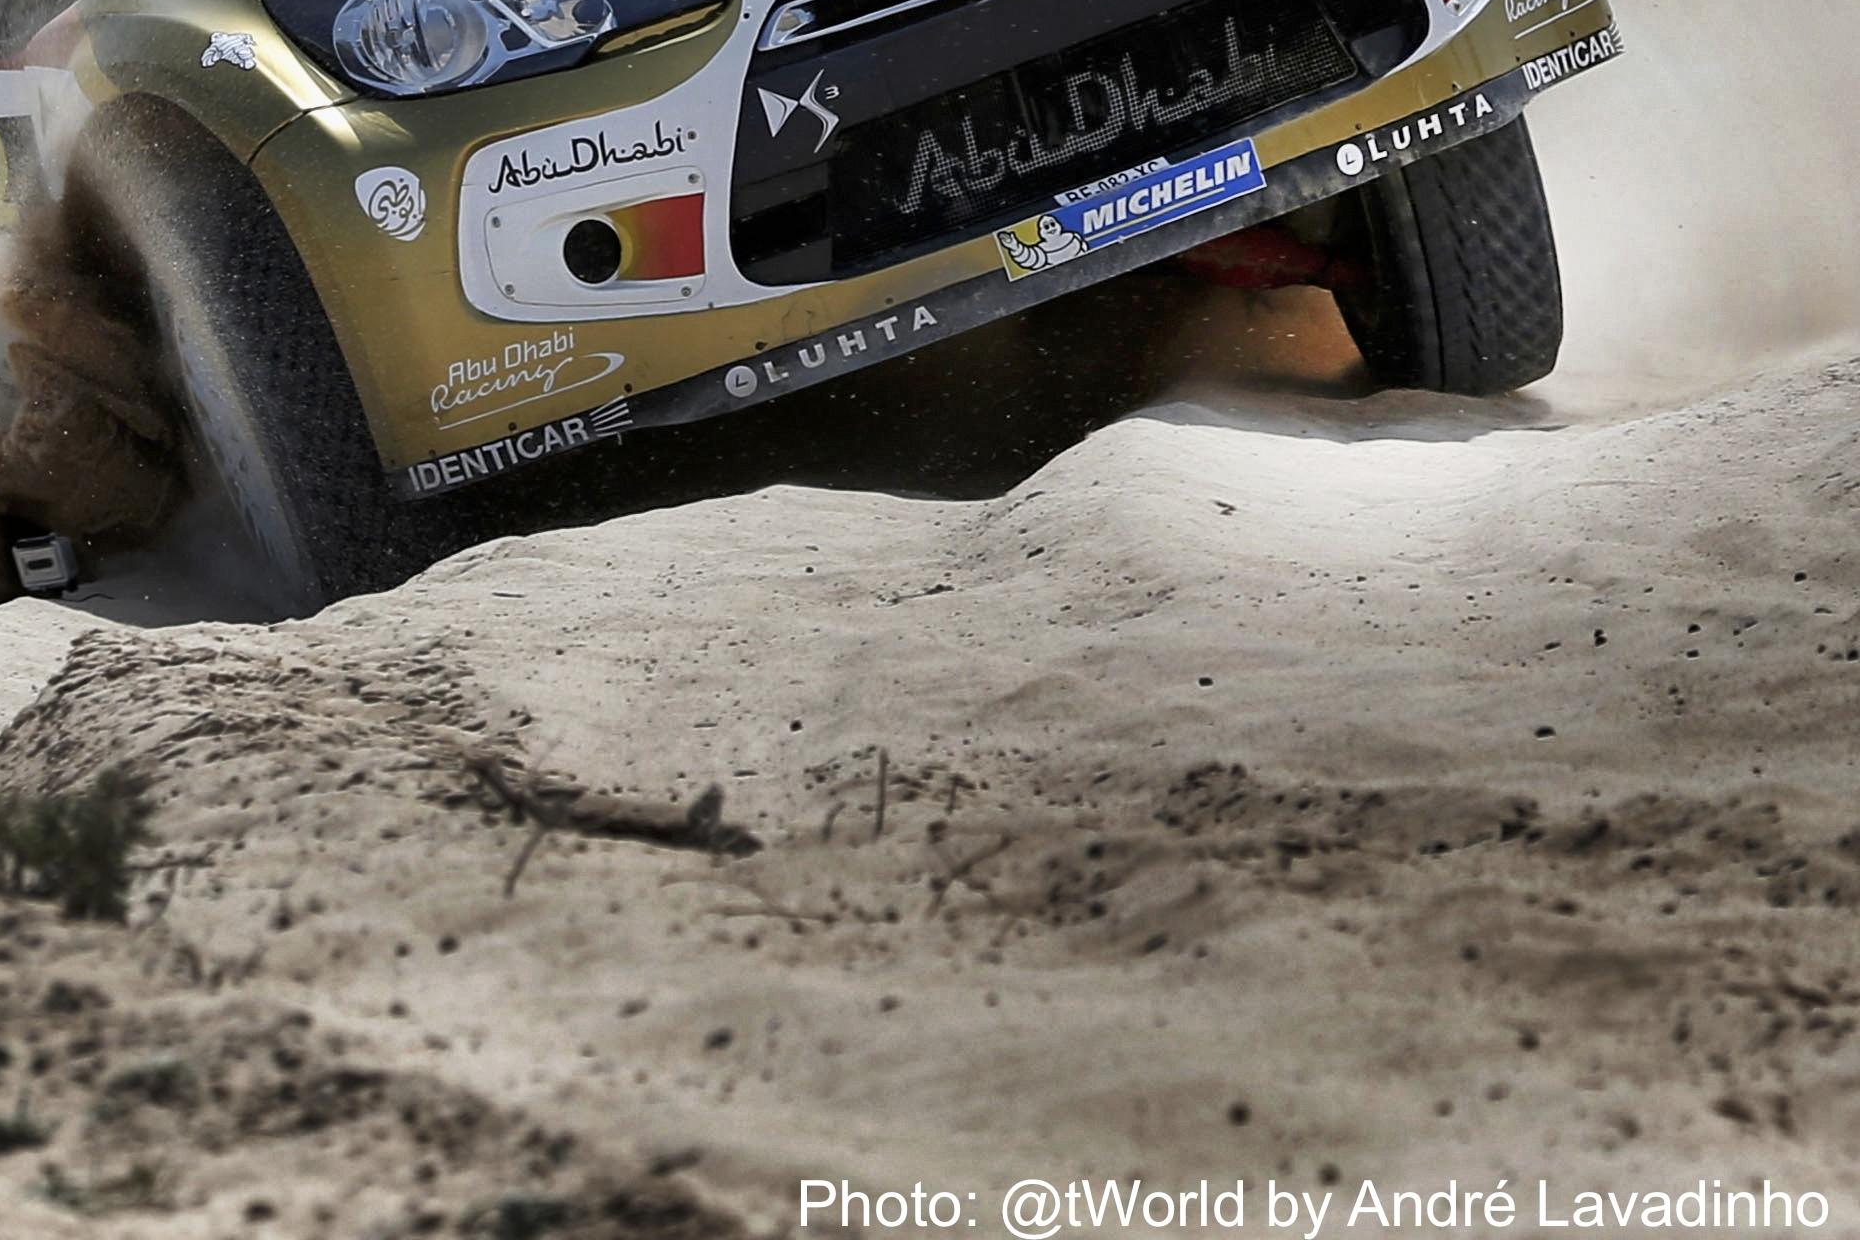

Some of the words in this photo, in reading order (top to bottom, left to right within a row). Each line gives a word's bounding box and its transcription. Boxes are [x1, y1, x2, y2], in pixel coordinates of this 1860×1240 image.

[1522, 31, 1614, 90] IDENTICAR
[1368, 94, 1493, 162] LUHTA
[1083, 151, 1251, 234] MICHELIN
[447, 354, 498, 386] Abu
[504, 327, 576, 369] Dhabi
[764, 306, 938, 383] LUHTA
[431, 358, 570, 413] Racing
[408, 417, 588, 492] IDENTICAR
